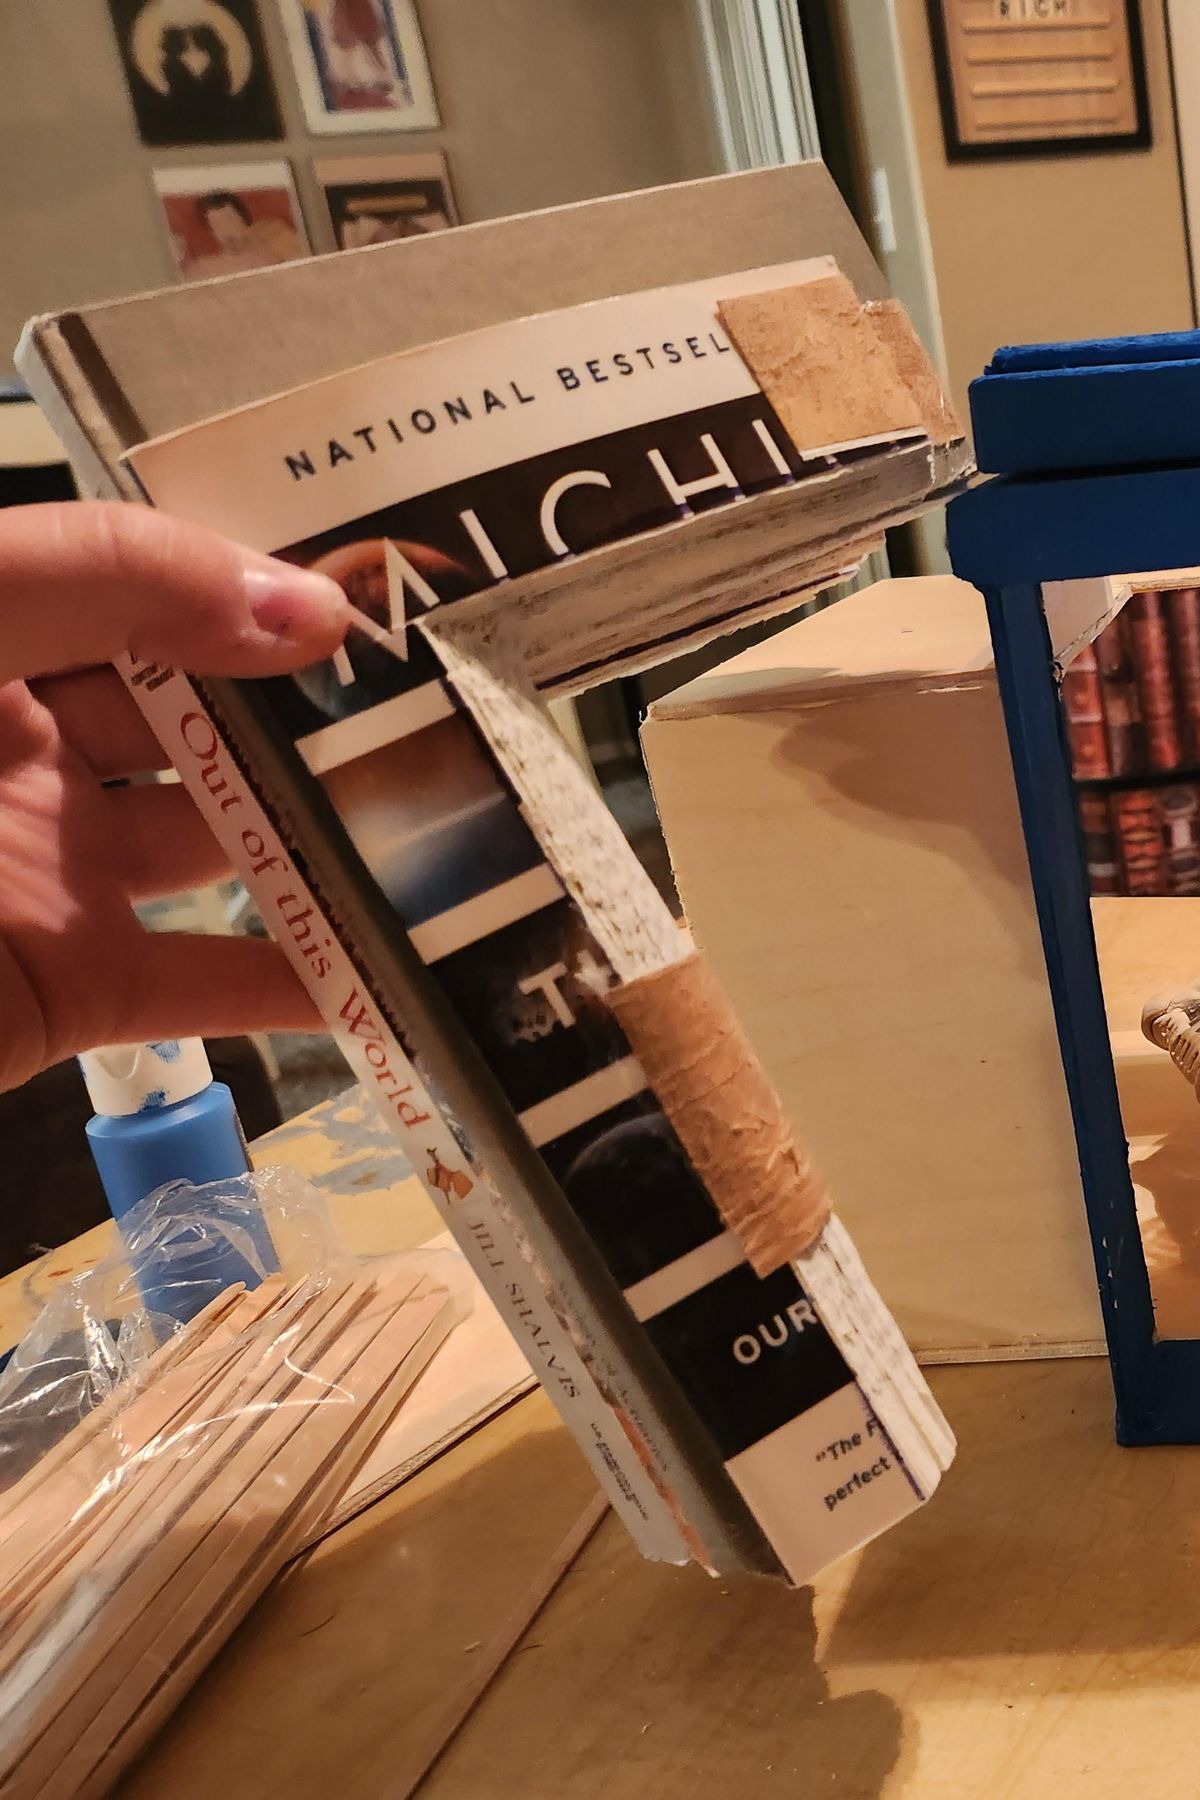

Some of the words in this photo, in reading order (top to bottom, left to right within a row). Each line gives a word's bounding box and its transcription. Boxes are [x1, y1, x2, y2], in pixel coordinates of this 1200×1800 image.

[284, 381, 535, 482] NATIONAL
[333, 419, 838, 687] MICHI
[180, 711, 243, 814] Out
[242, 829, 289, 876] of
[277, 895, 332, 979] this
[338, 987, 431, 1130] World
[467, 1220, 504, 1270] JILL
[506, 1282, 581, 1398] SHALVIS
[732, 1298, 818, 1365] OUR
[824, 1456, 891, 1511] perfect
